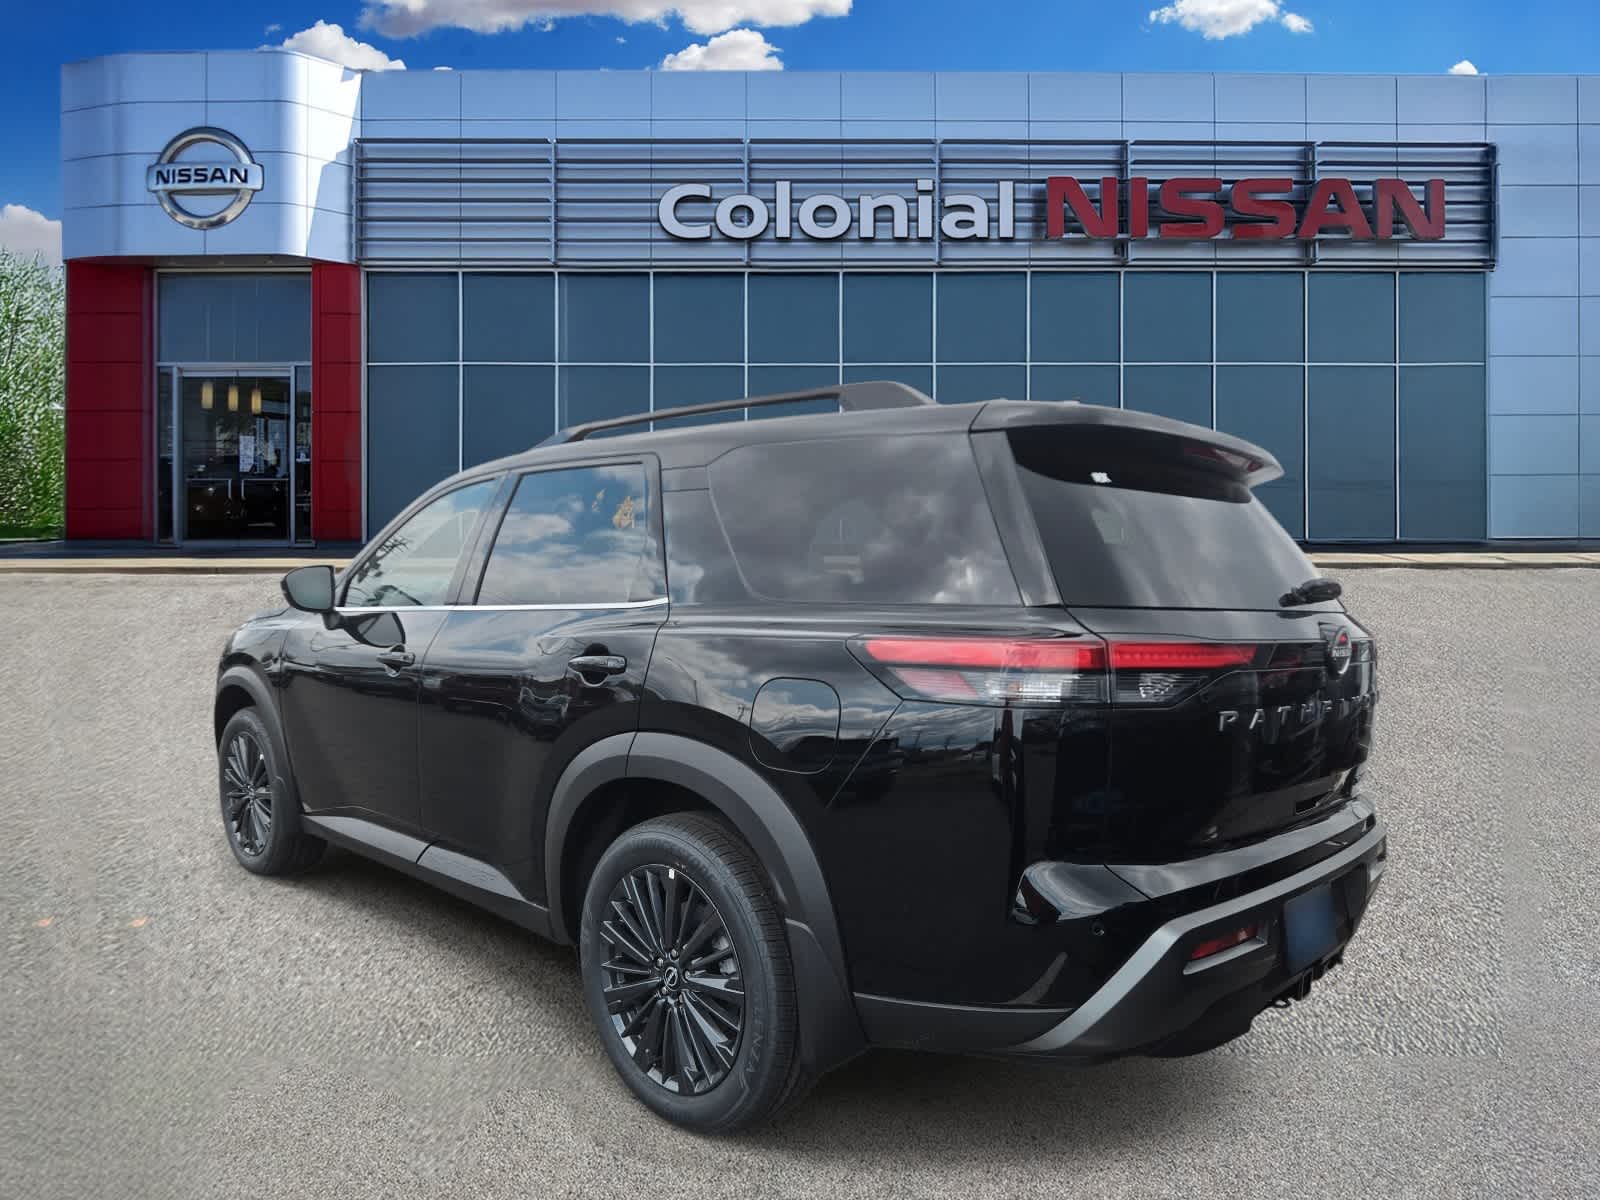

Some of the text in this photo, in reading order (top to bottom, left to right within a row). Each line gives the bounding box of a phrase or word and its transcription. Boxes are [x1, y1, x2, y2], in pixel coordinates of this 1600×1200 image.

[155, 167, 249, 185] NISSAN
[657, 176, 1446, 241] Colonial NISSAN
